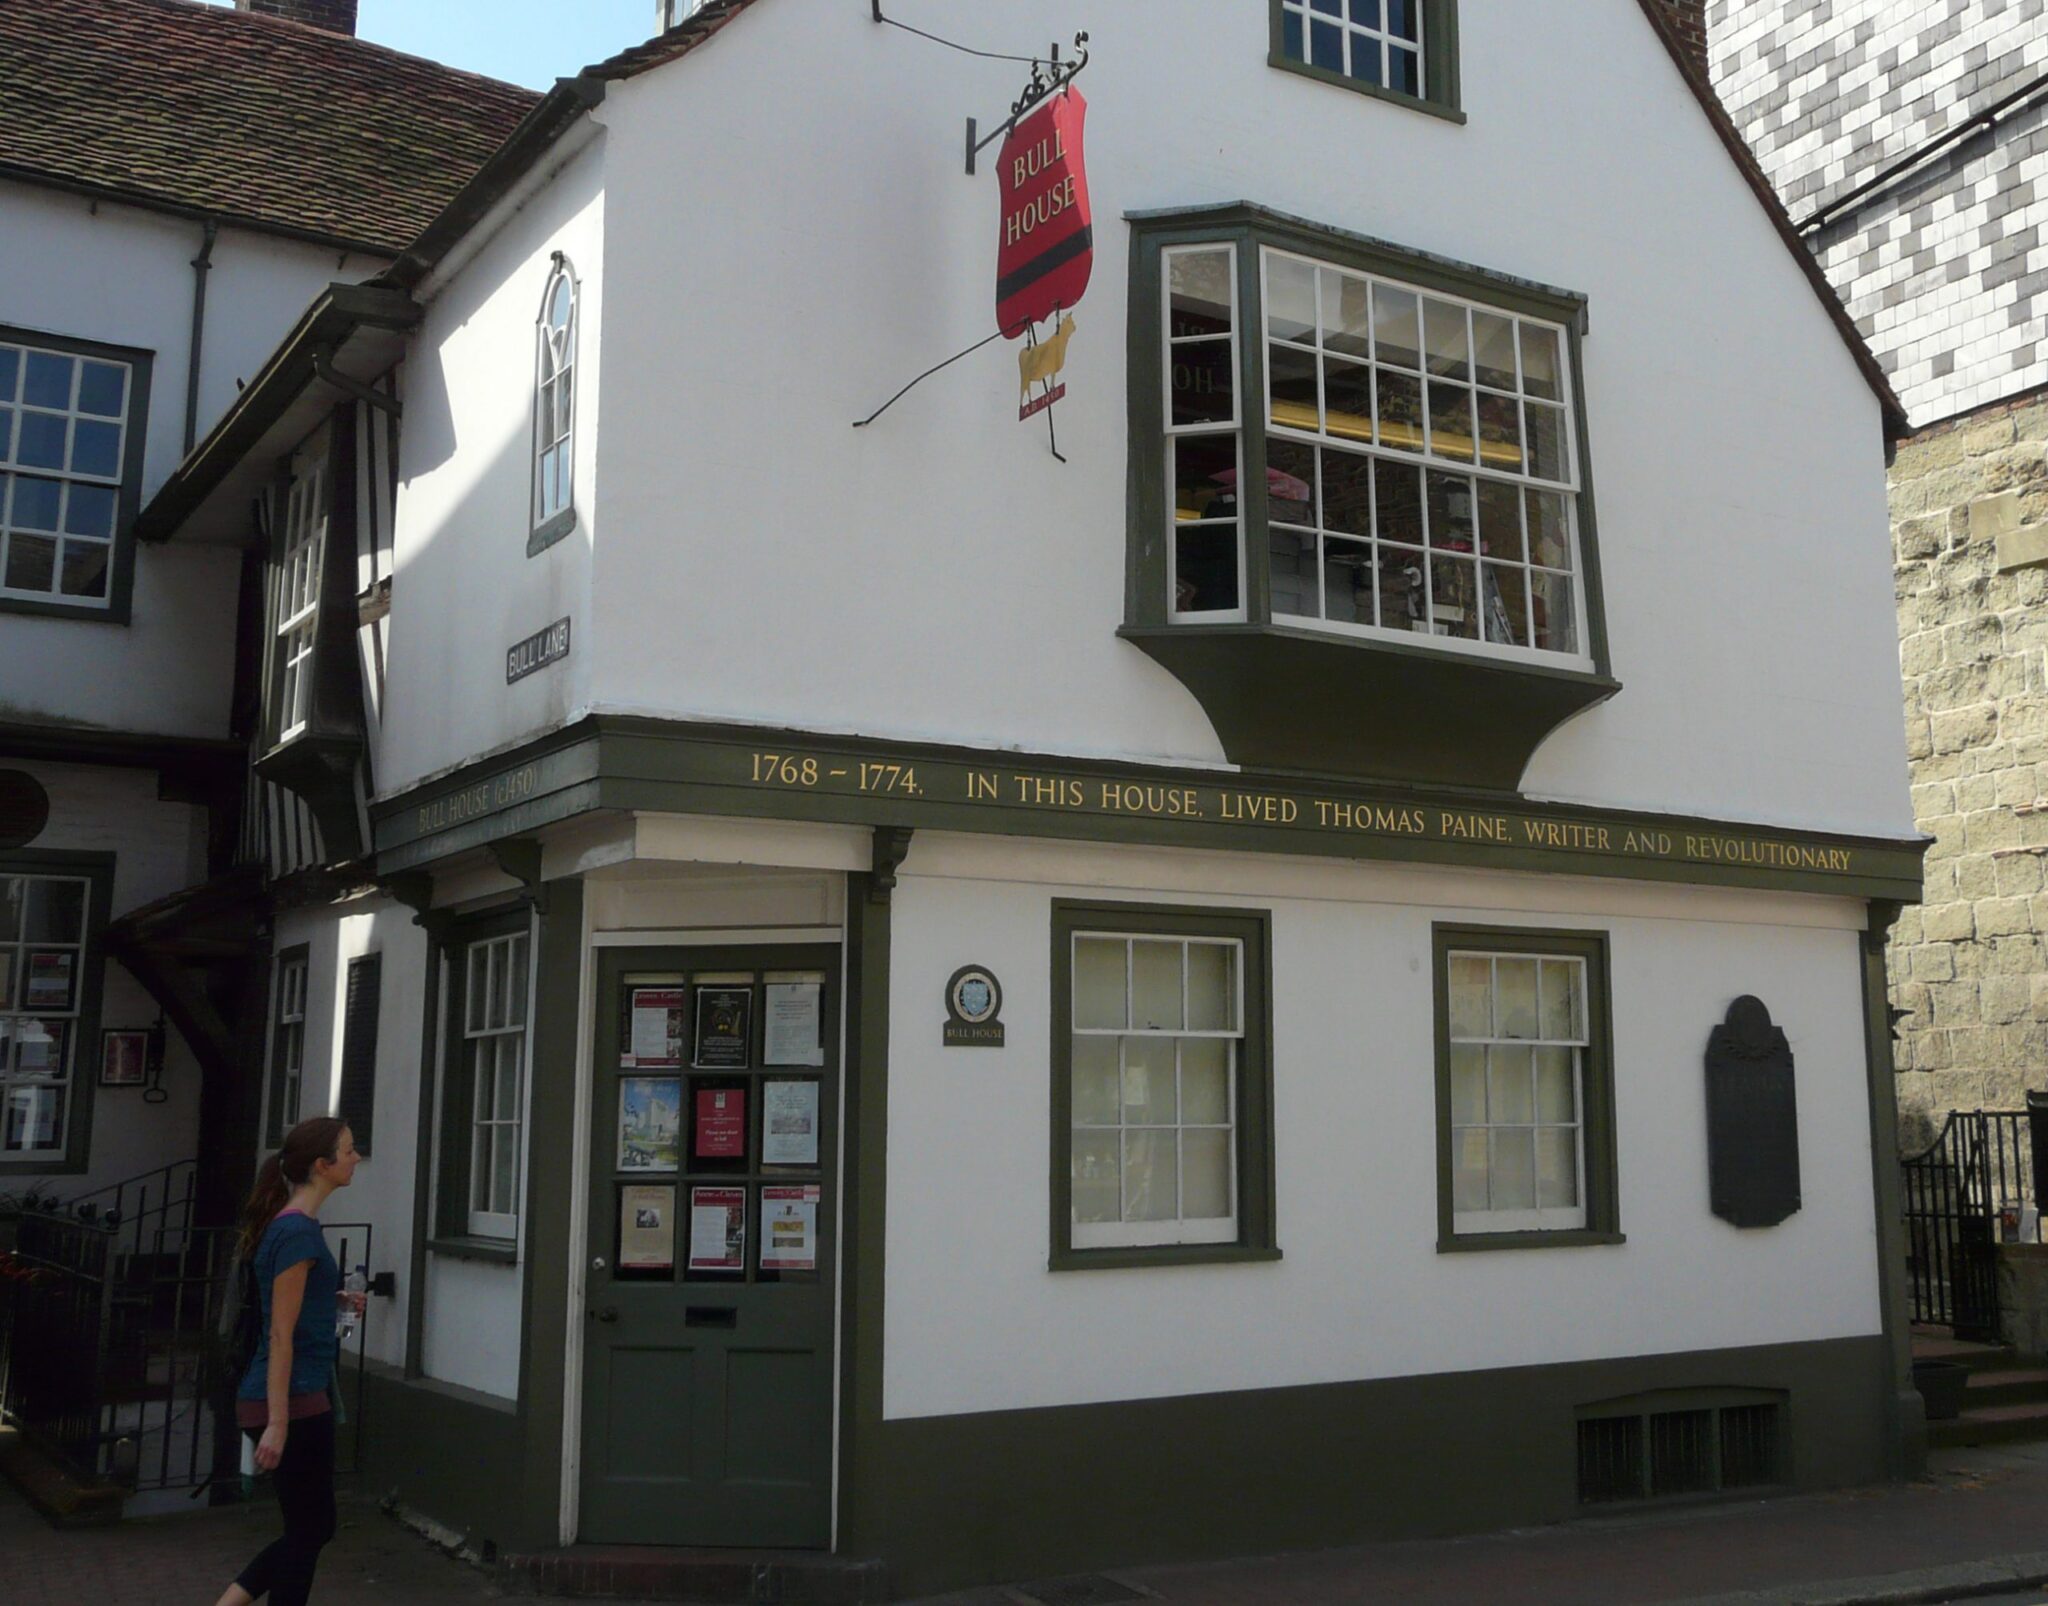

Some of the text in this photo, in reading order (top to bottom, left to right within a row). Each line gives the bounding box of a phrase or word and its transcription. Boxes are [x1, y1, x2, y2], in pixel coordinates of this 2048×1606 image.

[1013, 128, 1067, 190] BULL
[1006, 173, 1077, 247] HOUSE
[508, 623, 566, 678] BULL LANE
[419, 801, 446, 833] BULL
[449, 784, 489, 823] HOUSE
[752, 753, 819, 786] 1768
[967, 772, 998, 799] IN
[1014, 775, 1084, 806] THIS
[1221, 793, 1298, 823] LIVED
[1314, 800, 1425, 834] THOMAS
[1524, 820, 1611, 850] WRITER
[1624, 830, 1672, 855] AND
[1686, 835, 1851, 871] REVOLUTIONARY
[946, 1028, 1003, 1039] BULL HOUSE
